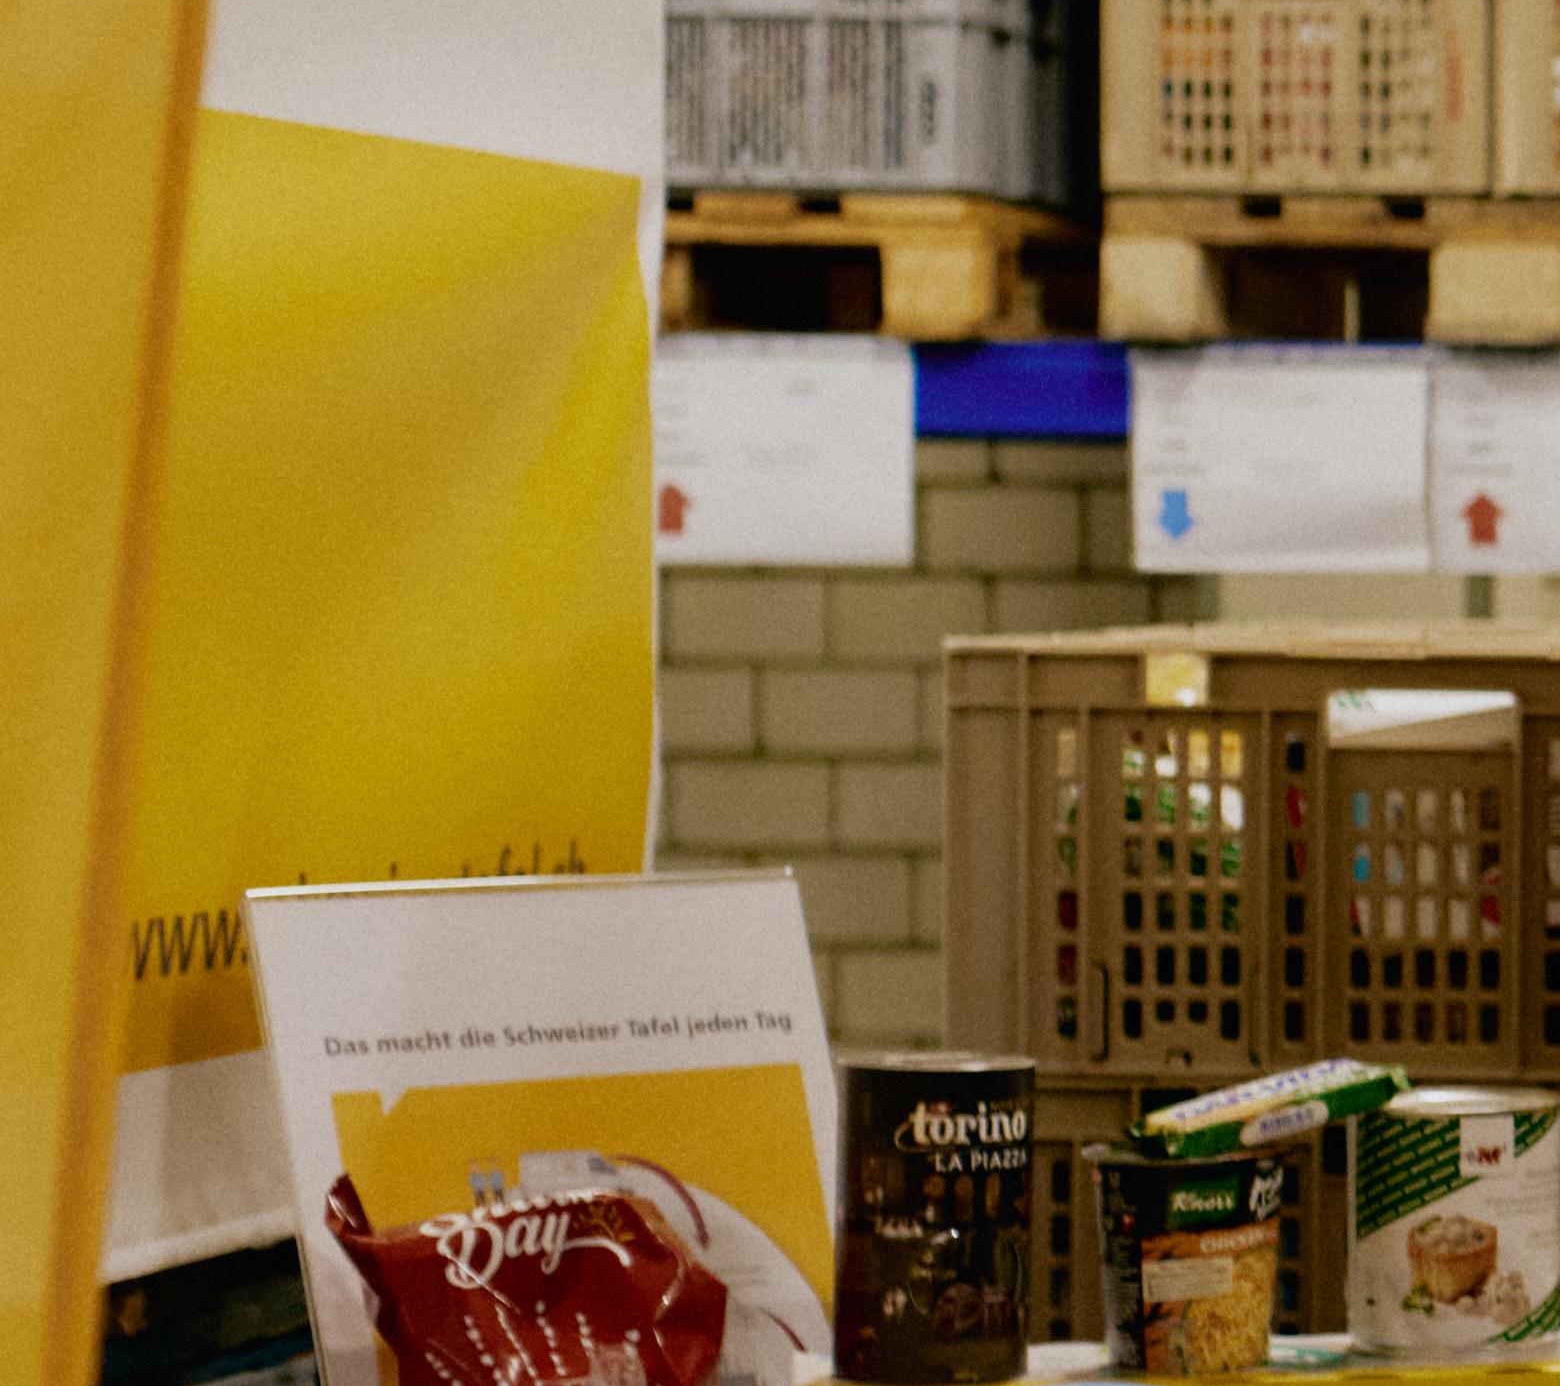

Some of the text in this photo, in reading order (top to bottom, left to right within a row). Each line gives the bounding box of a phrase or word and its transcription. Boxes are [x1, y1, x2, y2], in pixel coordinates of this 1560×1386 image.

[324, 1011, 793, 1056] Das macht die Schweizer Tafel jeden Tag
[908, 1101, 1027, 1147] torino
[934, 1151, 964, 1173] LA
[436, 1211, 632, 1290] Day
